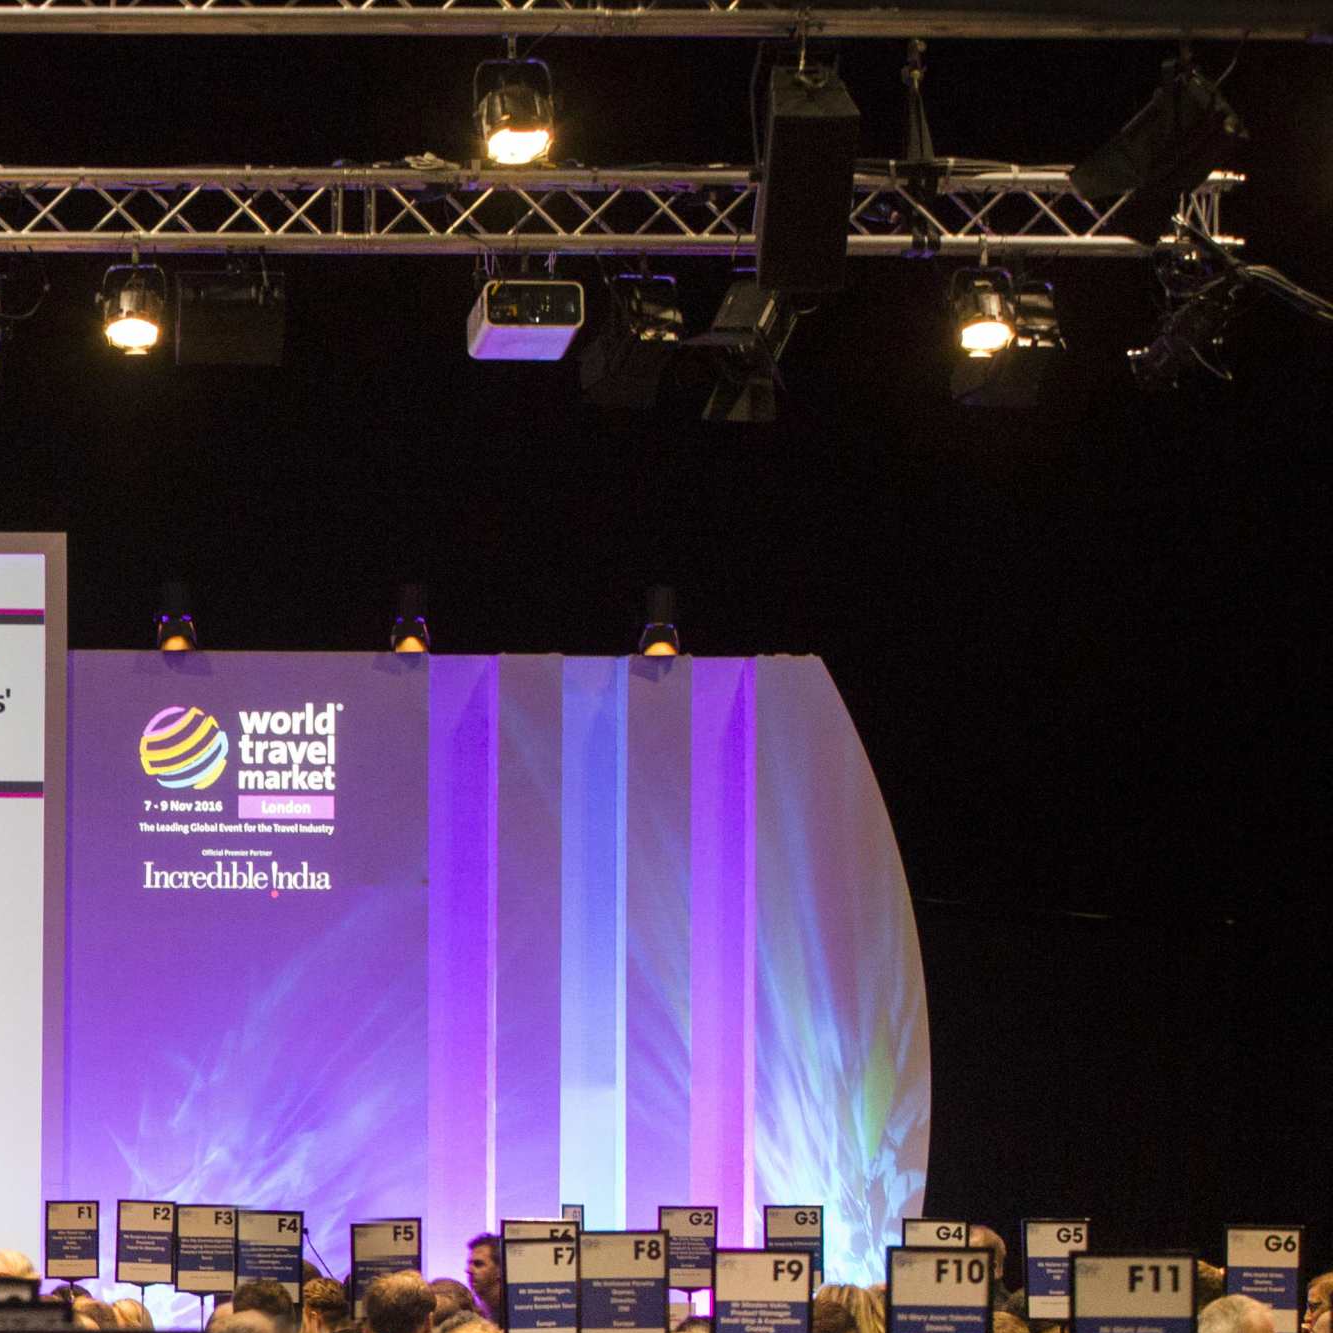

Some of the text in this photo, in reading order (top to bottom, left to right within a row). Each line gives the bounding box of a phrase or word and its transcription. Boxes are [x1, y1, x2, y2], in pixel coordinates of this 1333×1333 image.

[238, 702, 335, 735] world
[238, 735, 335, 765] travel
[238, 764, 336, 790] market
[144, 801, 152, 811] 7
[160, 801, 168, 811] 9
[170, 801, 193, 811] Nov
[194, 801, 223, 812] 2016
[261, 800, 311, 814] London
[139, 822, 334, 835] The Leading Global Event for the Travel Industry
[201, 849, 273, 857] Official Premier Partner
[143, 861, 268, 889] Incredible
[77, 1207, 92, 1219] F1
[153, 1208, 171, 1220] F2
[215, 1211, 233, 1225] F3
[689, 1212, 713, 1226] G2
[795, 1211, 819, 1225] G3
[277, 1218, 299, 1233] F4
[393, 1225, 414, 1241] F5
[936, 1226, 964, 1241] G4
[1056, 1228, 1083, 1244] G5
[1265, 1235, 1297, 1252] G6
[554, 1247, 575, 1265] F7
[634, 1240, 662, 1260] F8
[773, 1260, 803, 1282] F9
[936, 1259, 984, 1284] F10
[1128, 1265, 1180, 1293] F11
